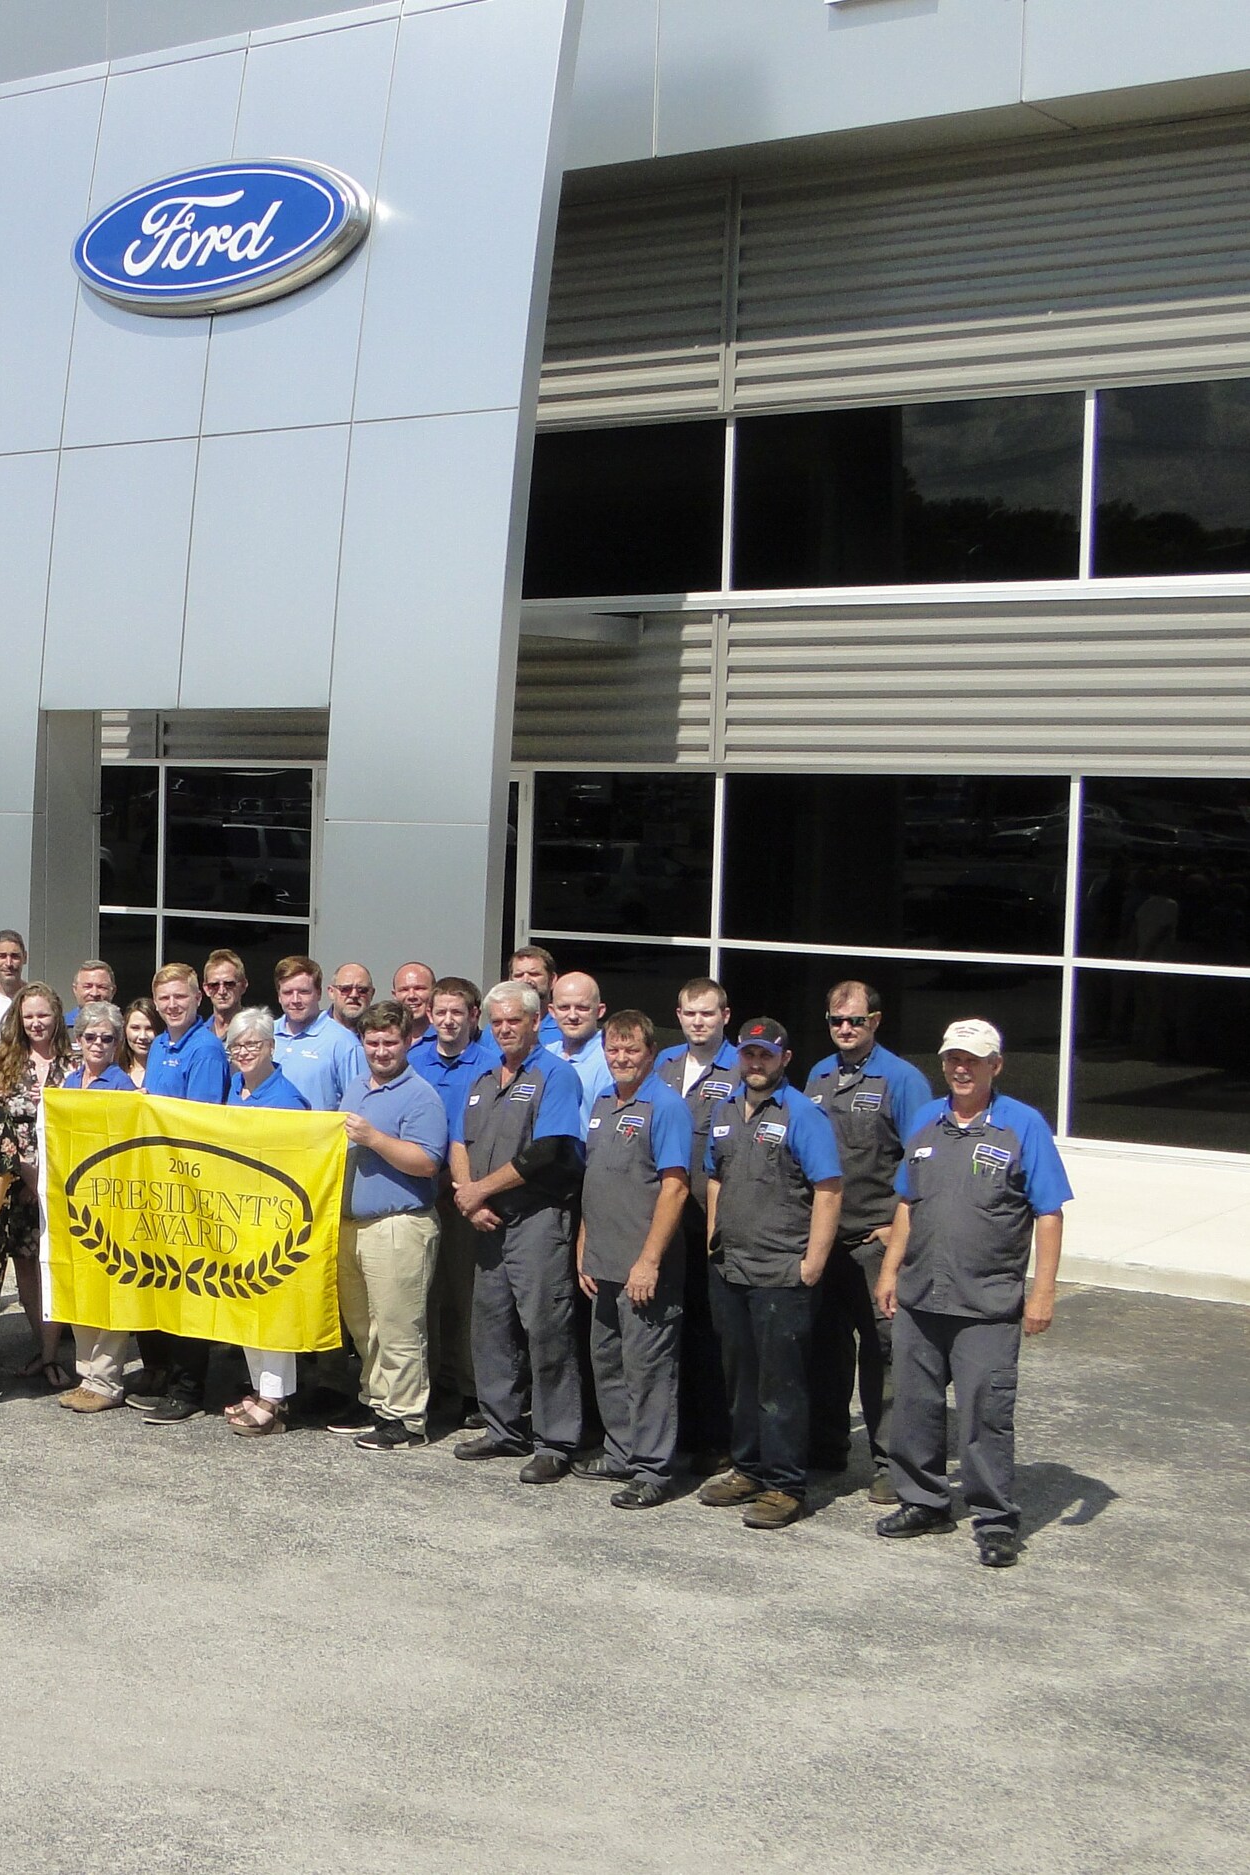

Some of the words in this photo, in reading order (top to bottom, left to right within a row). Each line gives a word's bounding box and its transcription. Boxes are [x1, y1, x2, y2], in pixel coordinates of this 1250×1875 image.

[123, 190, 283, 276] Ford
[168, 1157, 201, 1178] 2016
[90, 1177, 293, 1230] PRESIDENT'S
[128, 1212, 238, 1255] AWARD
